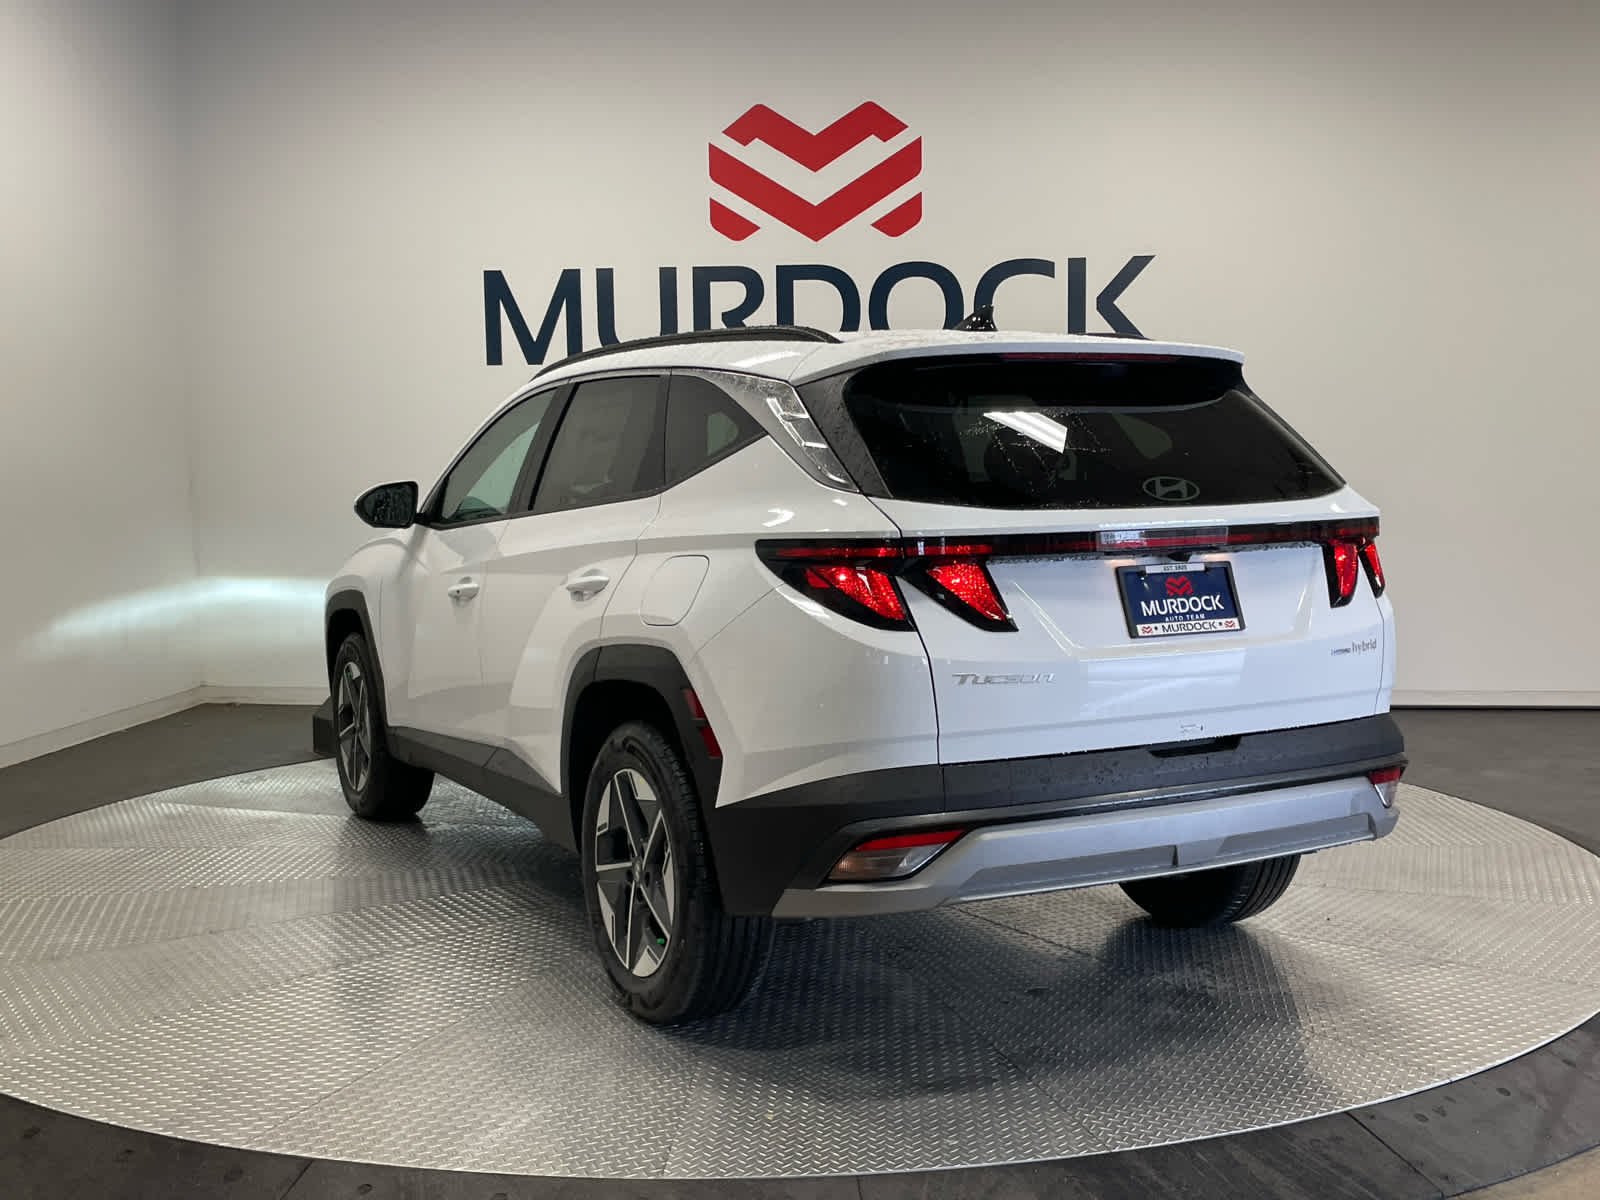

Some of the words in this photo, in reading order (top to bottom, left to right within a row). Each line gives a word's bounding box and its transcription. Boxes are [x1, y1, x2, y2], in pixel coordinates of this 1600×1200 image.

[483, 255, 1155, 366] MURDOCK
[1140, 594, 1224, 617] MURDOCK
[1161, 621, 1217, 633] MURDOCK
[1352, 638, 1377, 655] hybrid
